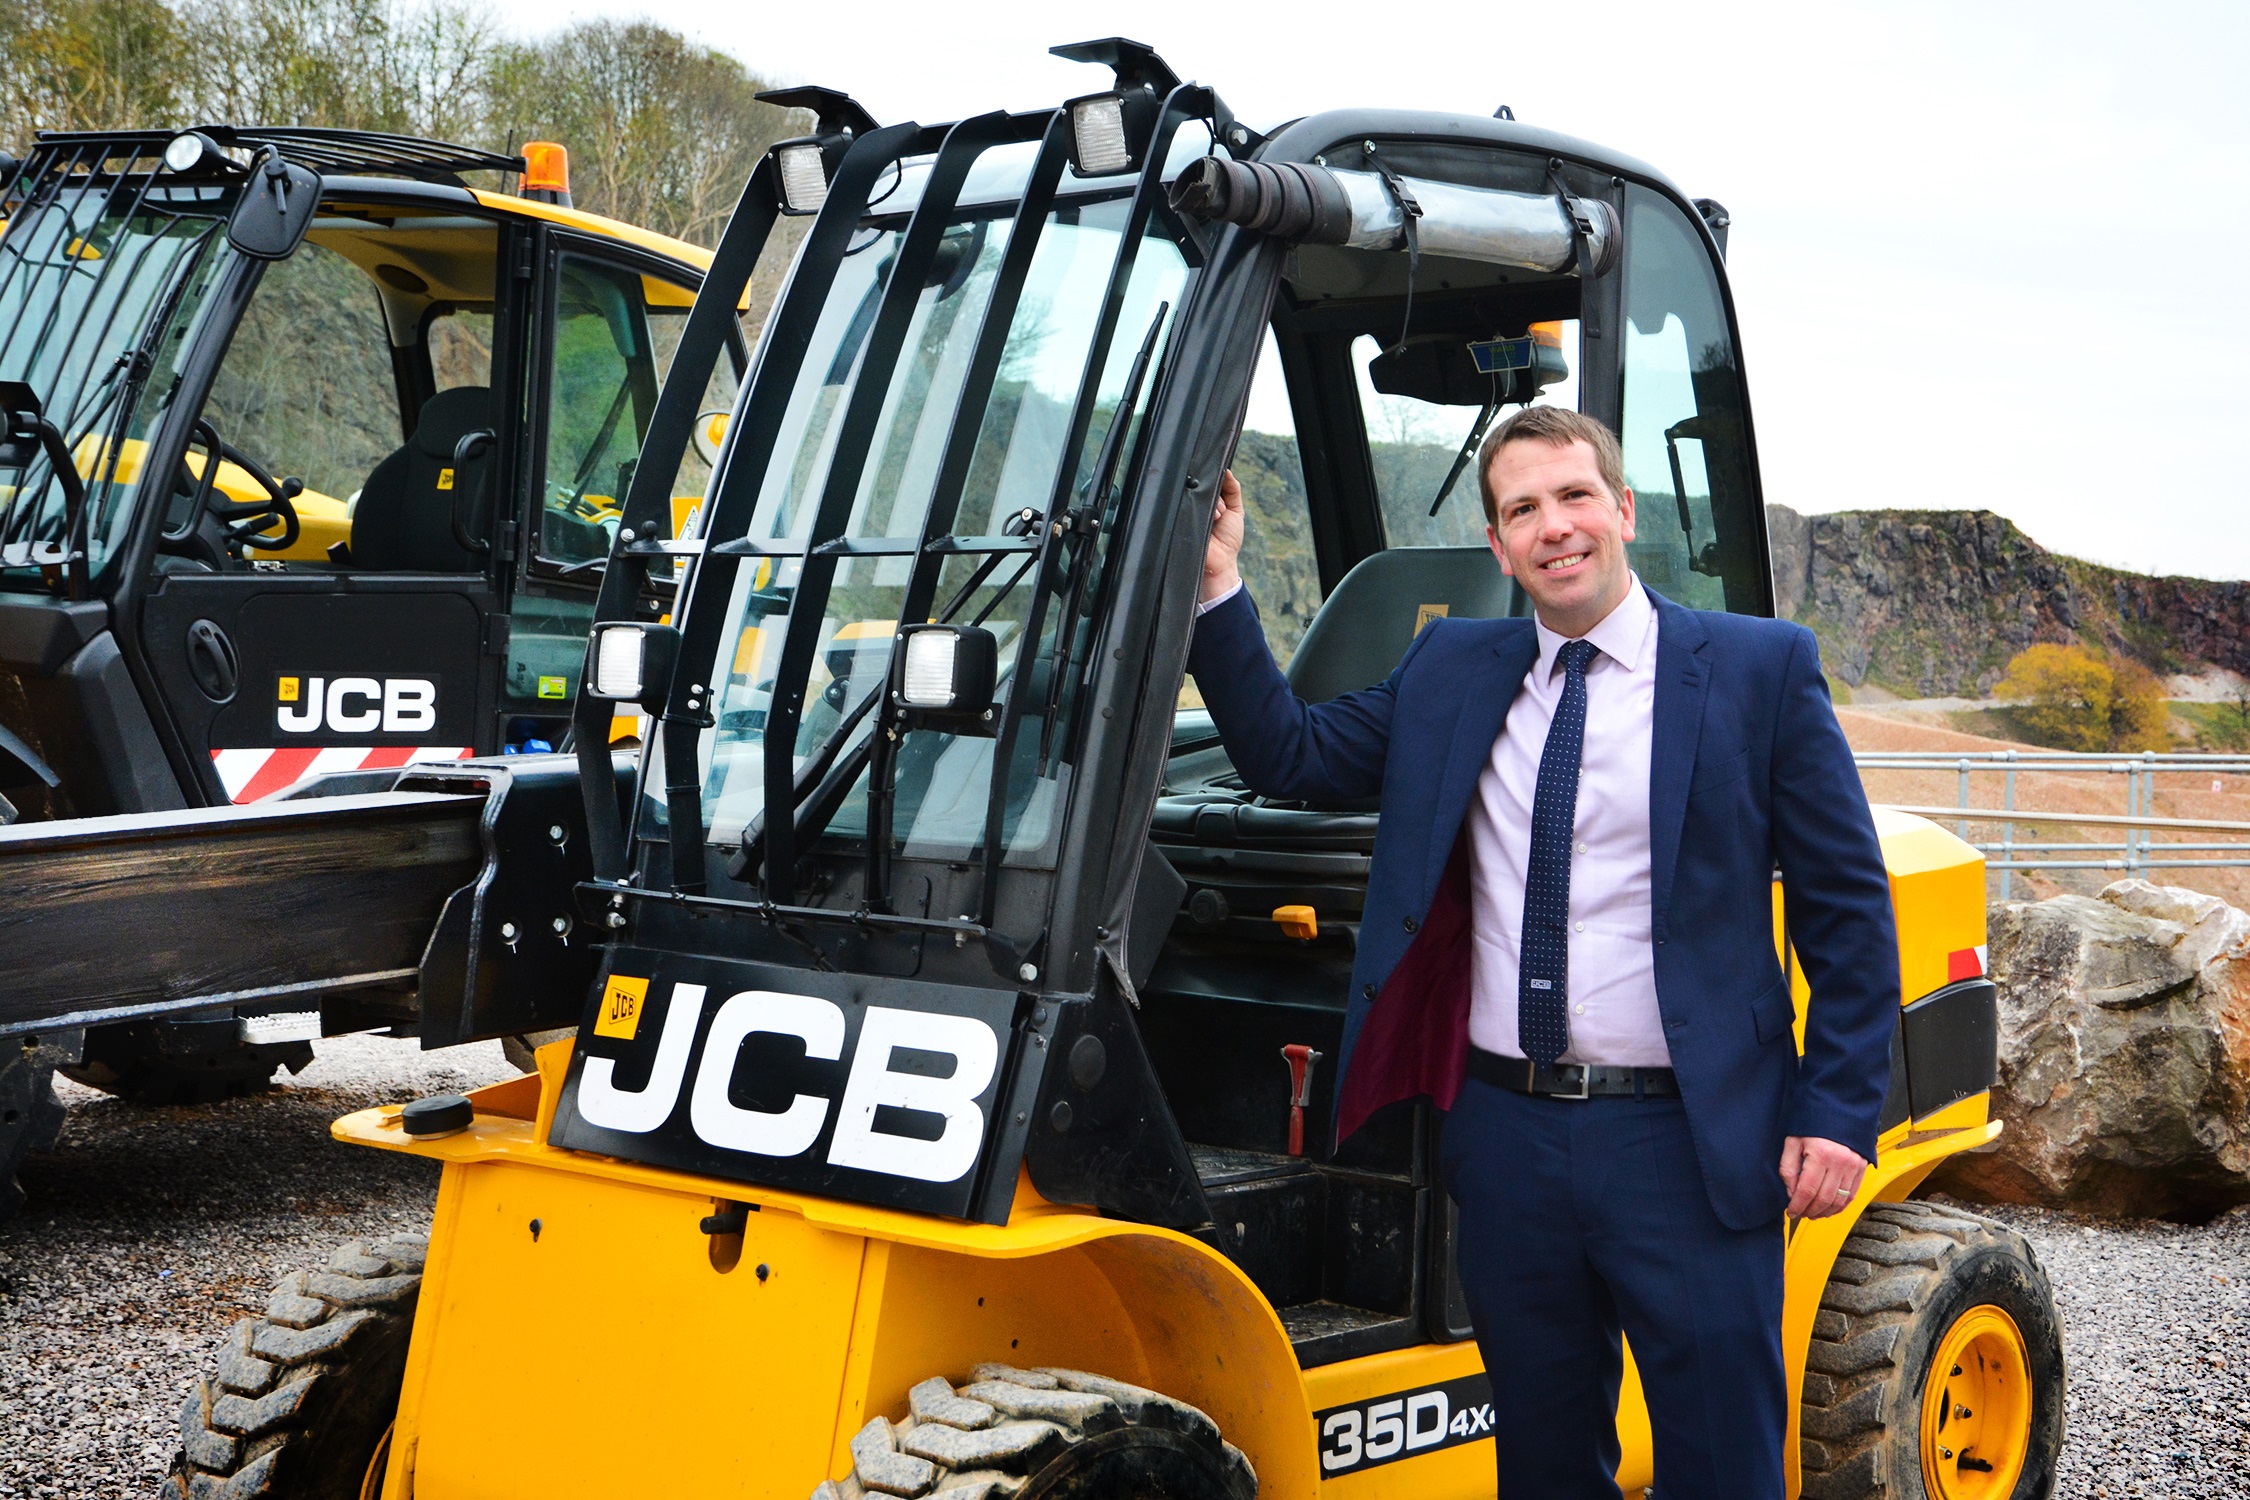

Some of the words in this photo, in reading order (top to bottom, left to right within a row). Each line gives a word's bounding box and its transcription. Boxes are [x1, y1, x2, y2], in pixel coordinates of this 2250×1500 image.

[277, 677, 436, 733] JCB
[612, 992, 634, 1021] JCB
[577, 982, 999, 1183] JCB
[1322, 1390, 1449, 1471] 35D
